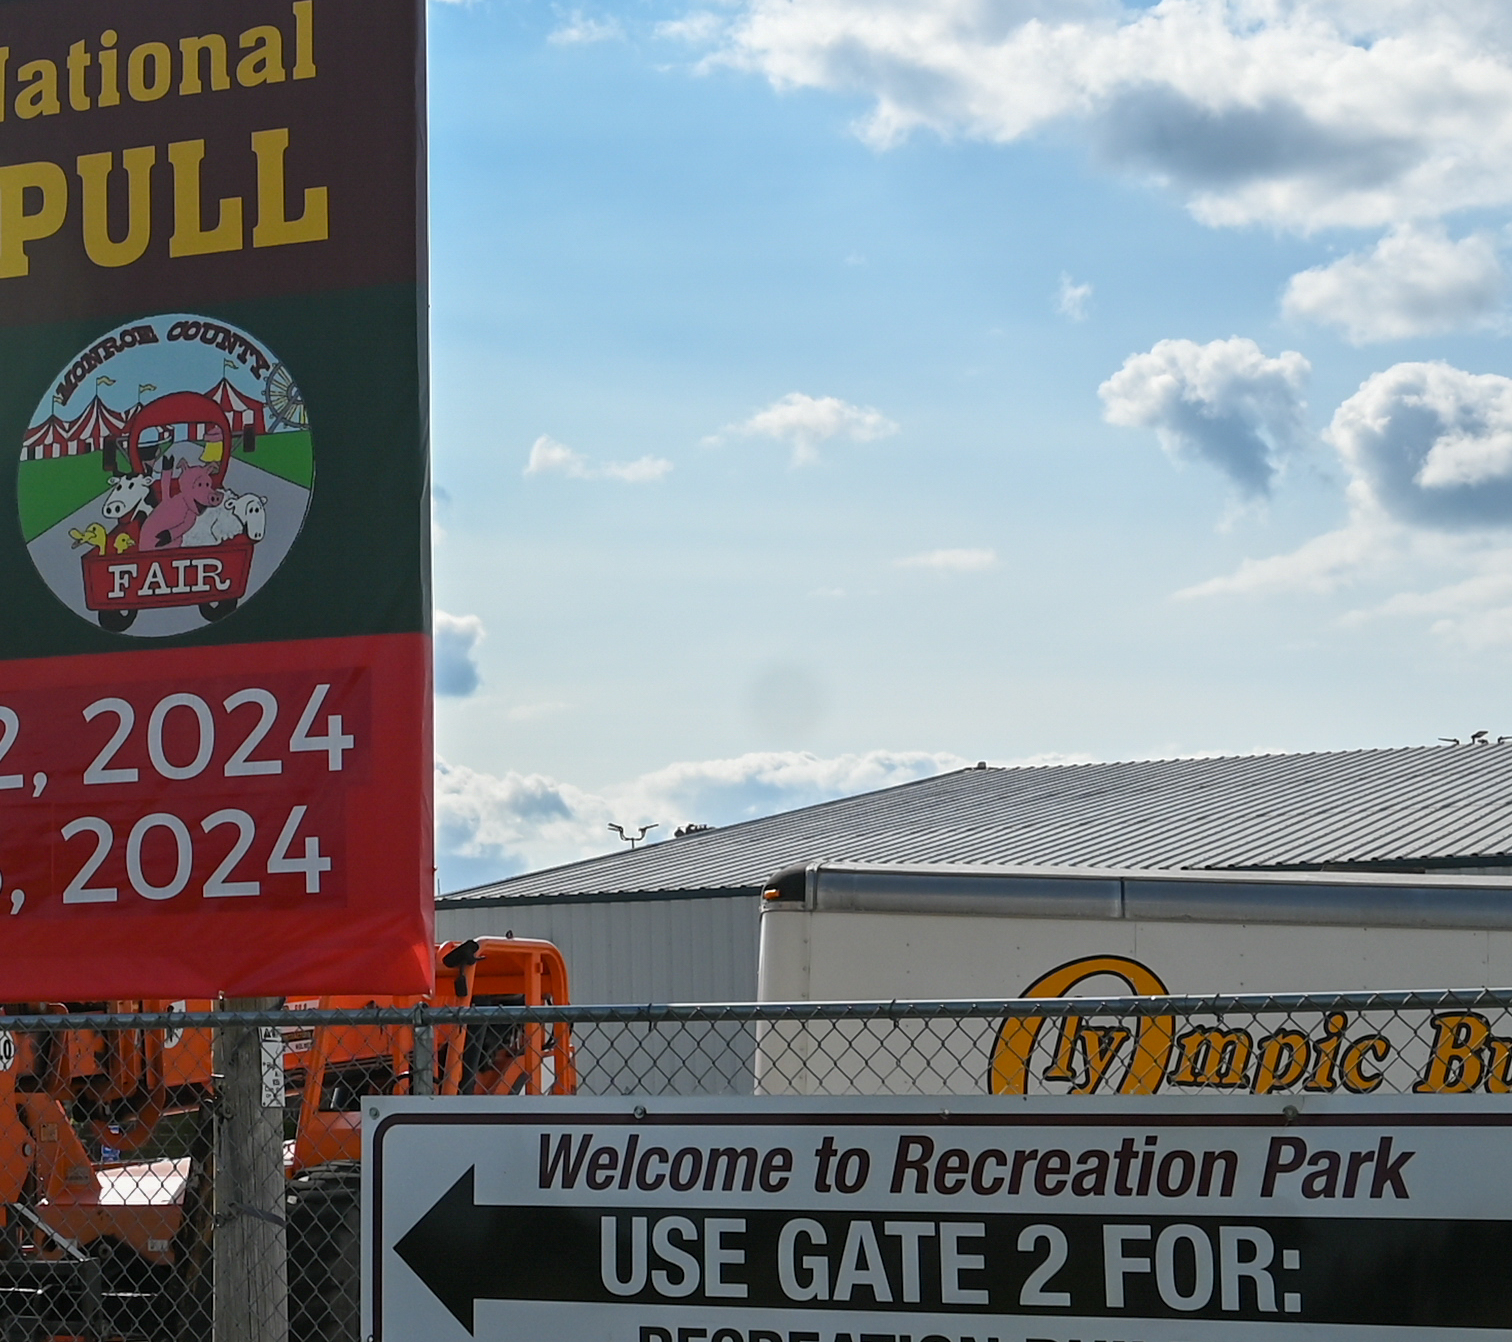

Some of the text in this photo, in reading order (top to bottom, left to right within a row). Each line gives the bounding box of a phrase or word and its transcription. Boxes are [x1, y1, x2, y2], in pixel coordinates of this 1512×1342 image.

[55, 321, 272, 407] MONROE COUNTY
[107, 558, 231, 599] FAIR
[83, 684, 354, 784] 2024
[62, 806, 330, 903] 2024
[539, 1134, 1417, 1199] Welcome to Recreation Park
[601, 1217, 1300, 1312] USE GATE 2 FOR:
